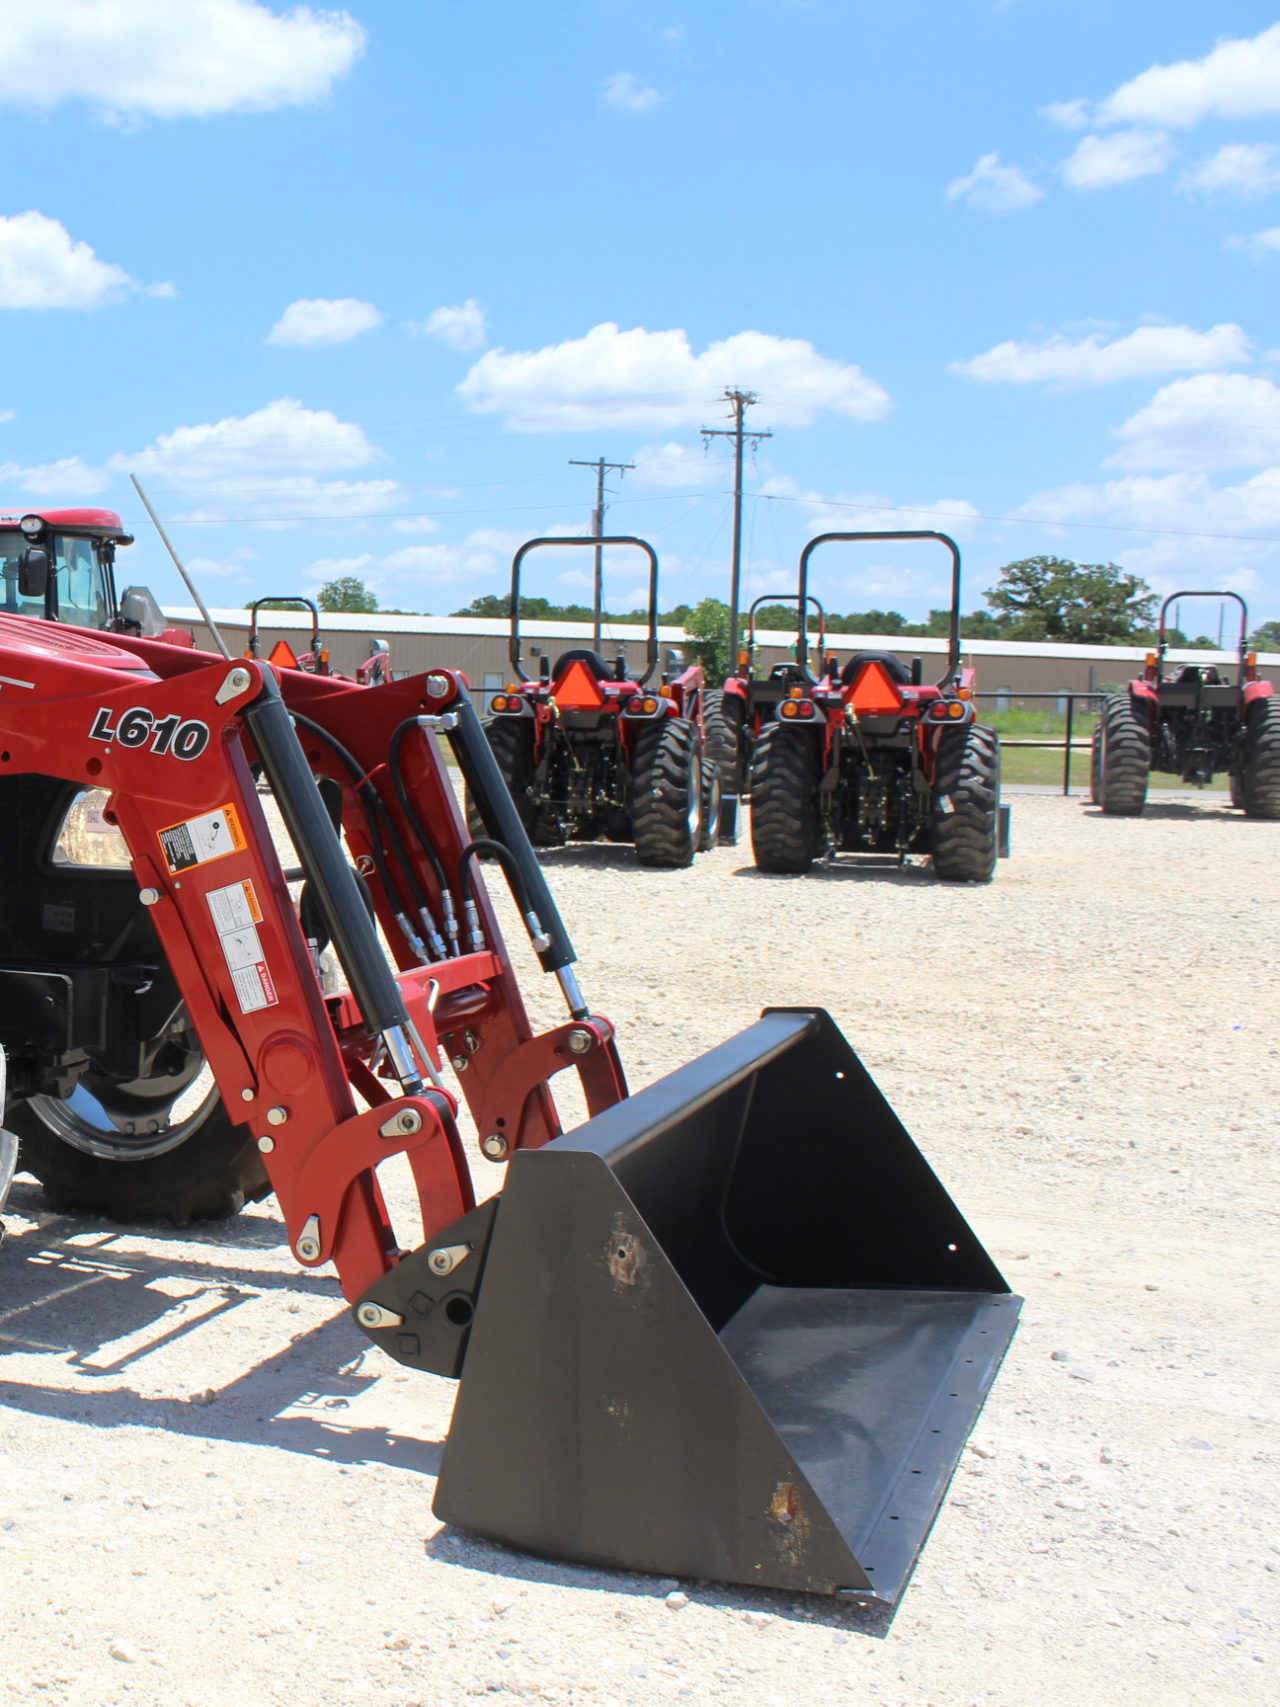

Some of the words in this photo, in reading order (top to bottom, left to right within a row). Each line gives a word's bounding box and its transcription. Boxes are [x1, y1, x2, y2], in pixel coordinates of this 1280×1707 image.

[88, 706, 210, 761] L610
[228, 816, 242, 847] WARNING
[258, 971, 274, 1003] DANGER
